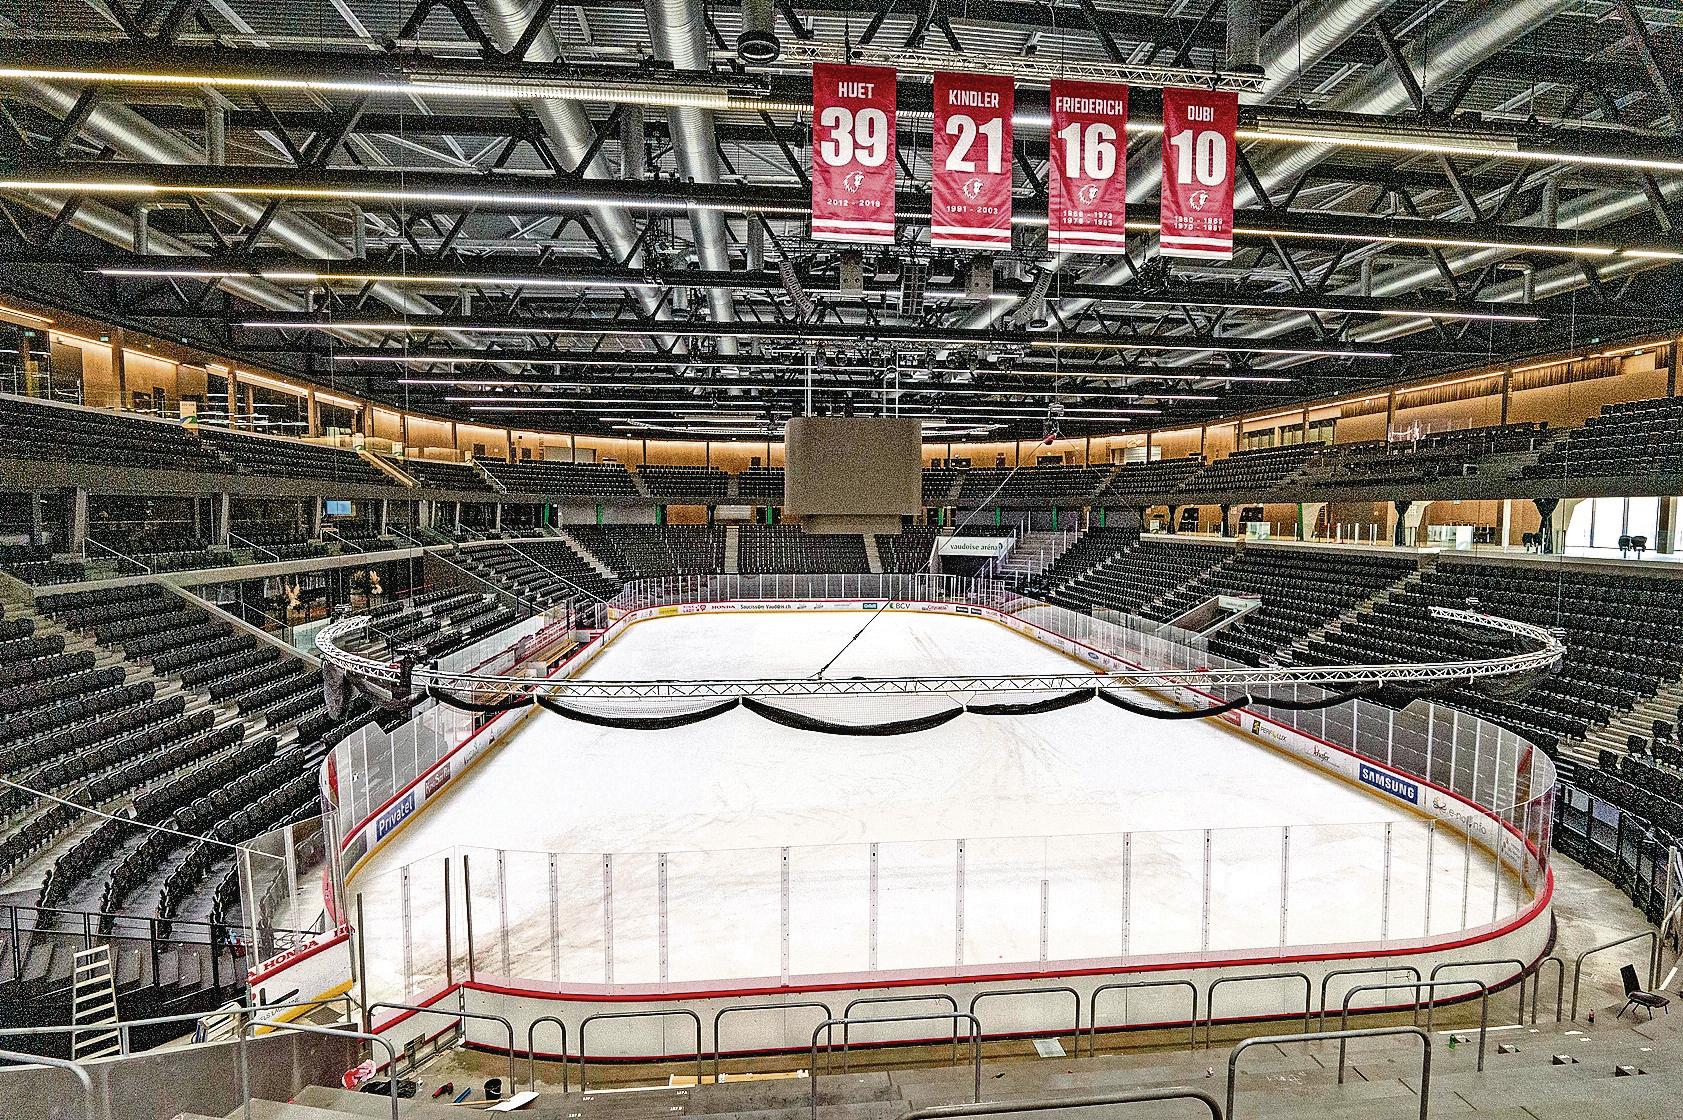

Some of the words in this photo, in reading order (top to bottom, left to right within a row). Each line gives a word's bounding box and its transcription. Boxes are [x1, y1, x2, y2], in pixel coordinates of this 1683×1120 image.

[838, 81, 874, 98] HUET
[949, 89, 999, 108] KINDLER
[1055, 96, 1123, 115] FRIEDERICH
[1187, 105, 1214, 122] DUBI
[820, 106, 888, 167] 39
[945, 114, 1003, 174] 21
[1057, 122, 1117, 180] 16
[1170, 129, 1227, 187] 10
[827, 198, 849, 207] 2012
[946, 205, 967, 213] 1991
[976, 206, 998, 215] 2003
[950, 542, 980, 550] vaudoise
[1362, 767, 1415, 799] SAMSUNG
[379, 794, 413, 837] Privatel
